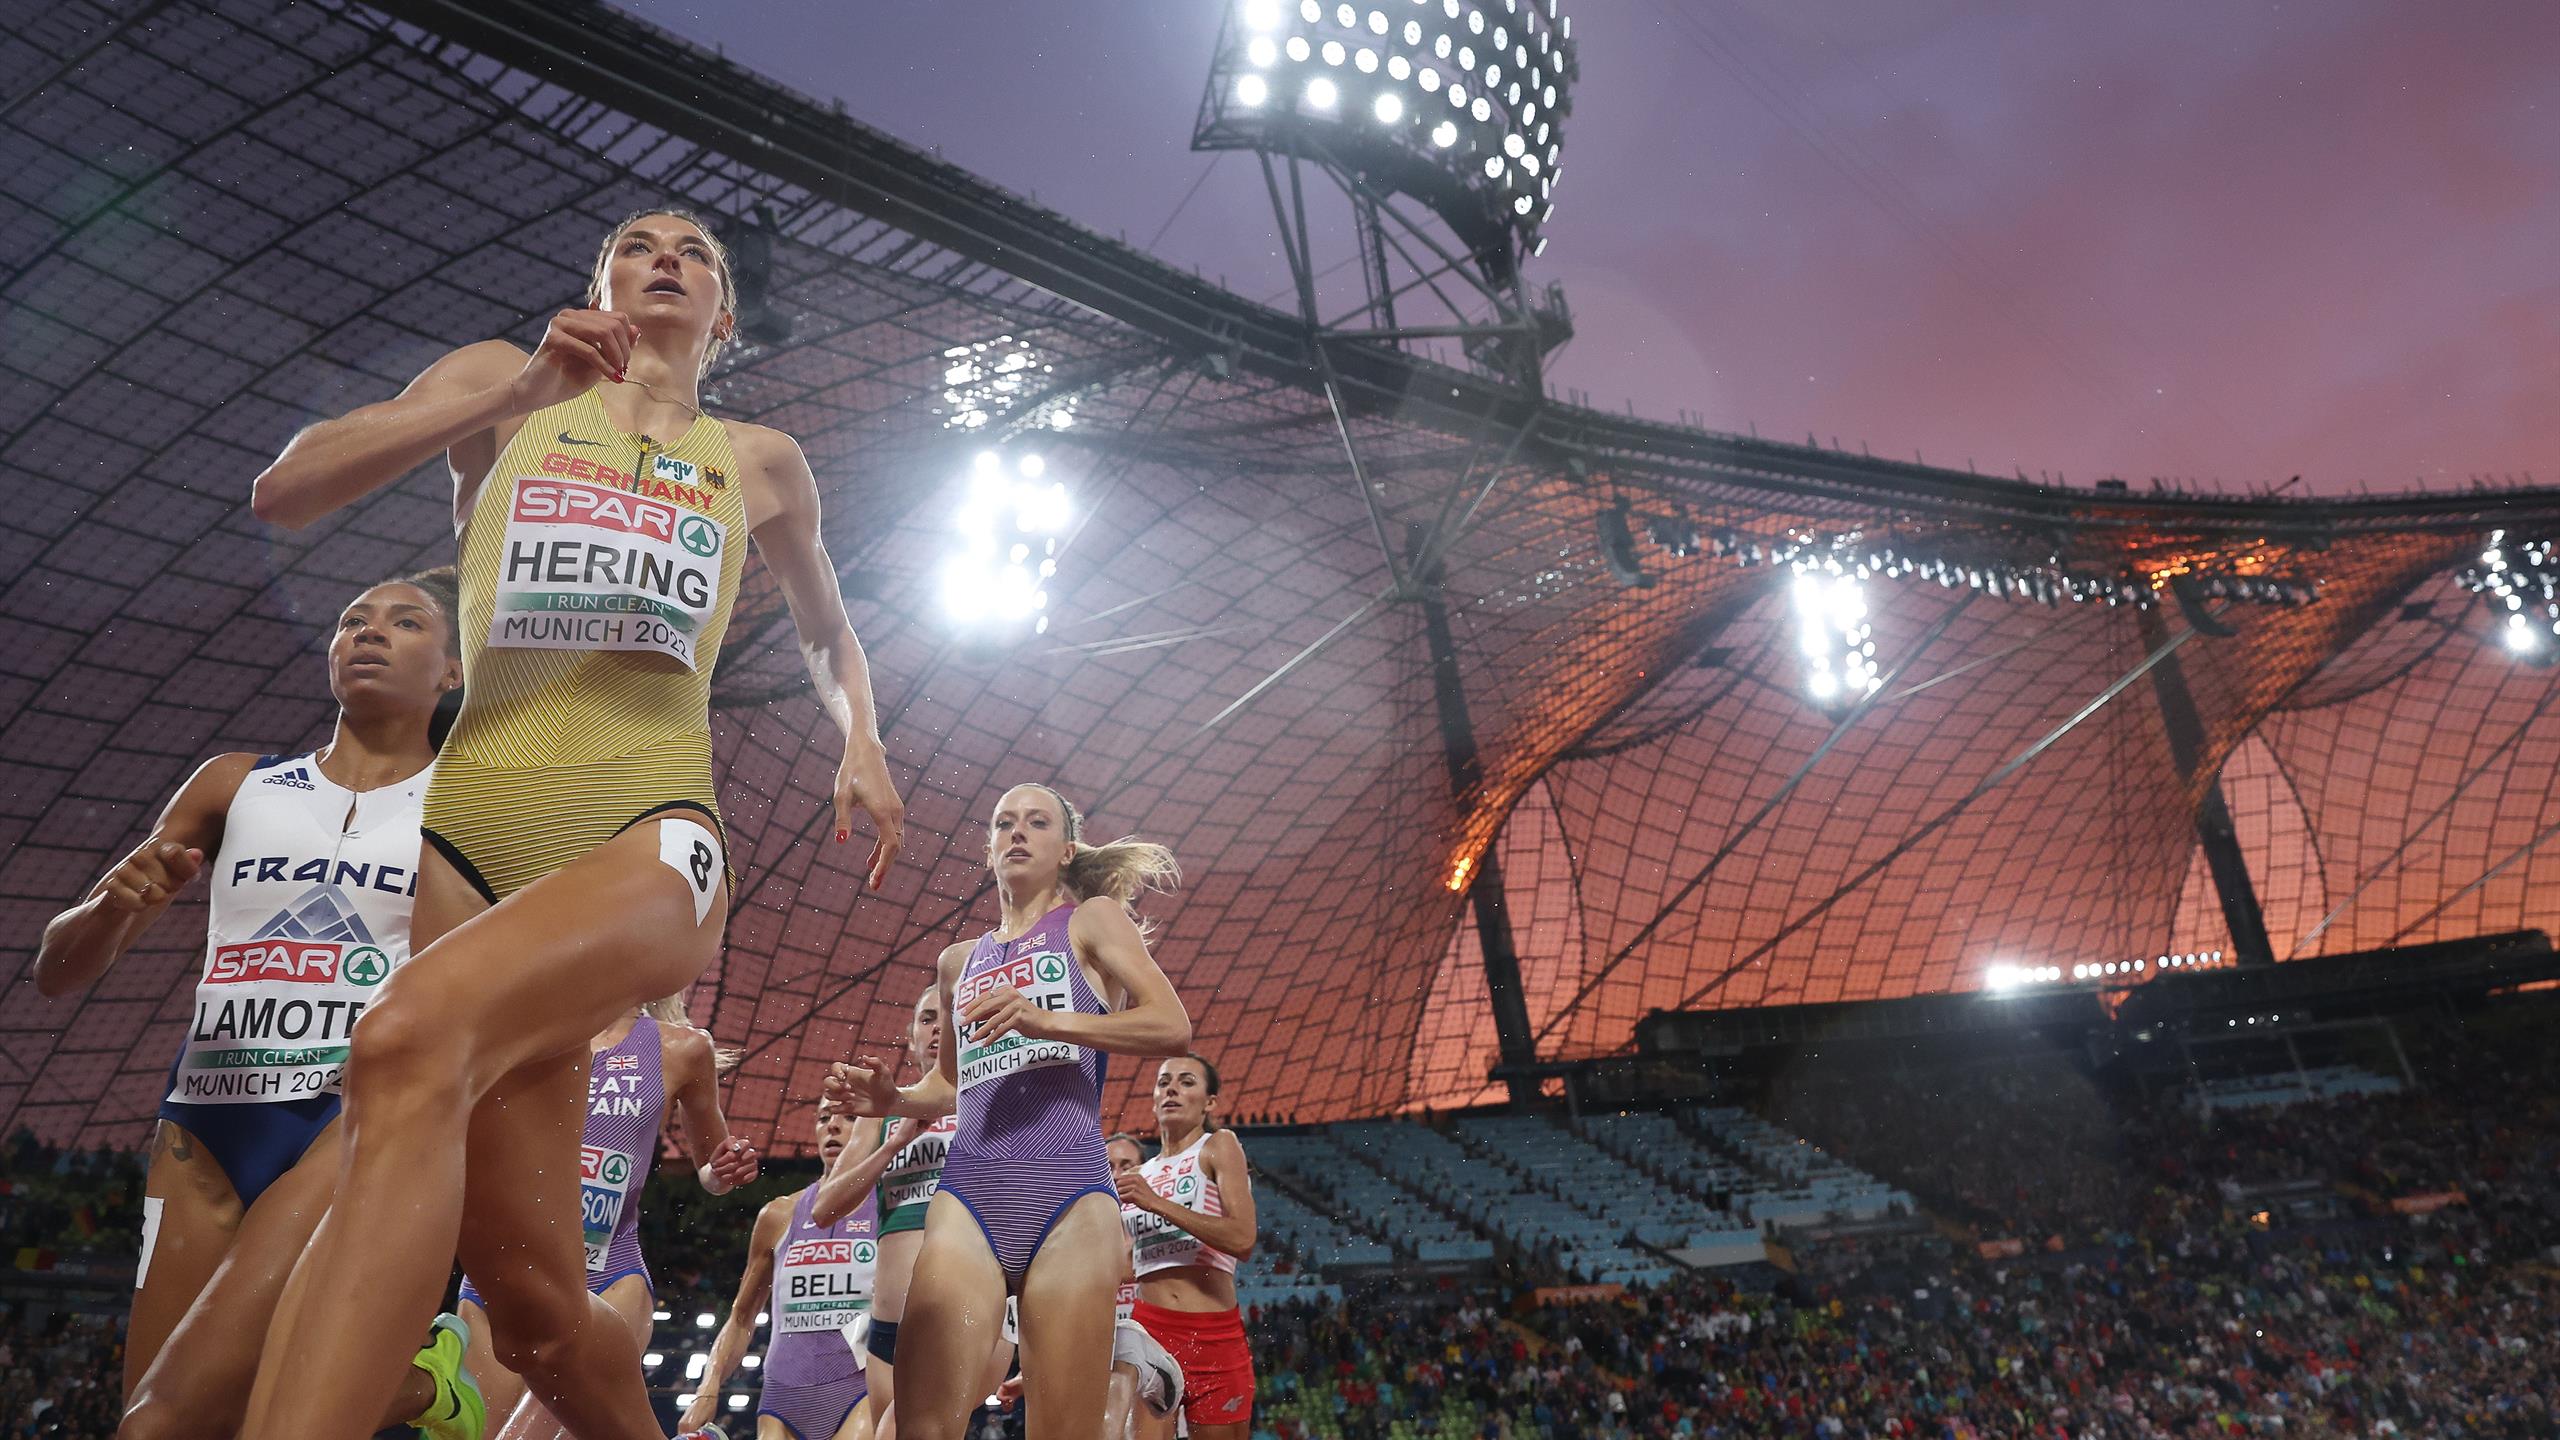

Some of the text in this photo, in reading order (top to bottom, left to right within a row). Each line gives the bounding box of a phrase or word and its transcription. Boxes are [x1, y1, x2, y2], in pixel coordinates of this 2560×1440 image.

[542, 453, 714, 509] GERMANY
[518, 486, 669, 536] SPAR
[507, 541, 709, 608] HERING
[547, 595, 552, 609] I
[557, 596, 599, 609] RUN
[504, 617, 688, 660] MUNICH 2022
[262, 777, 316, 791] adidas
[690, 840, 712, 893] 8
[212, 947, 336, 979] SPAR
[959, 963, 1032, 1006] SPAR
[217, 1053, 223, 1065] I
[225, 1052, 257, 1065] RUN
[961, 1045, 1071, 1084] MUNICH 2022
[983, 1044, 1005, 1056] RUN
[184, 1068, 343, 1096] MUNICH 202
[786, 1243, 850, 1265] SPAR
[1168, 1238, 1198, 1254] 2022
[791, 1273, 862, 1298] BELL
[784, 1314, 832, 1328] MUNICH
[1007, 1304, 1016, 1334] 4
